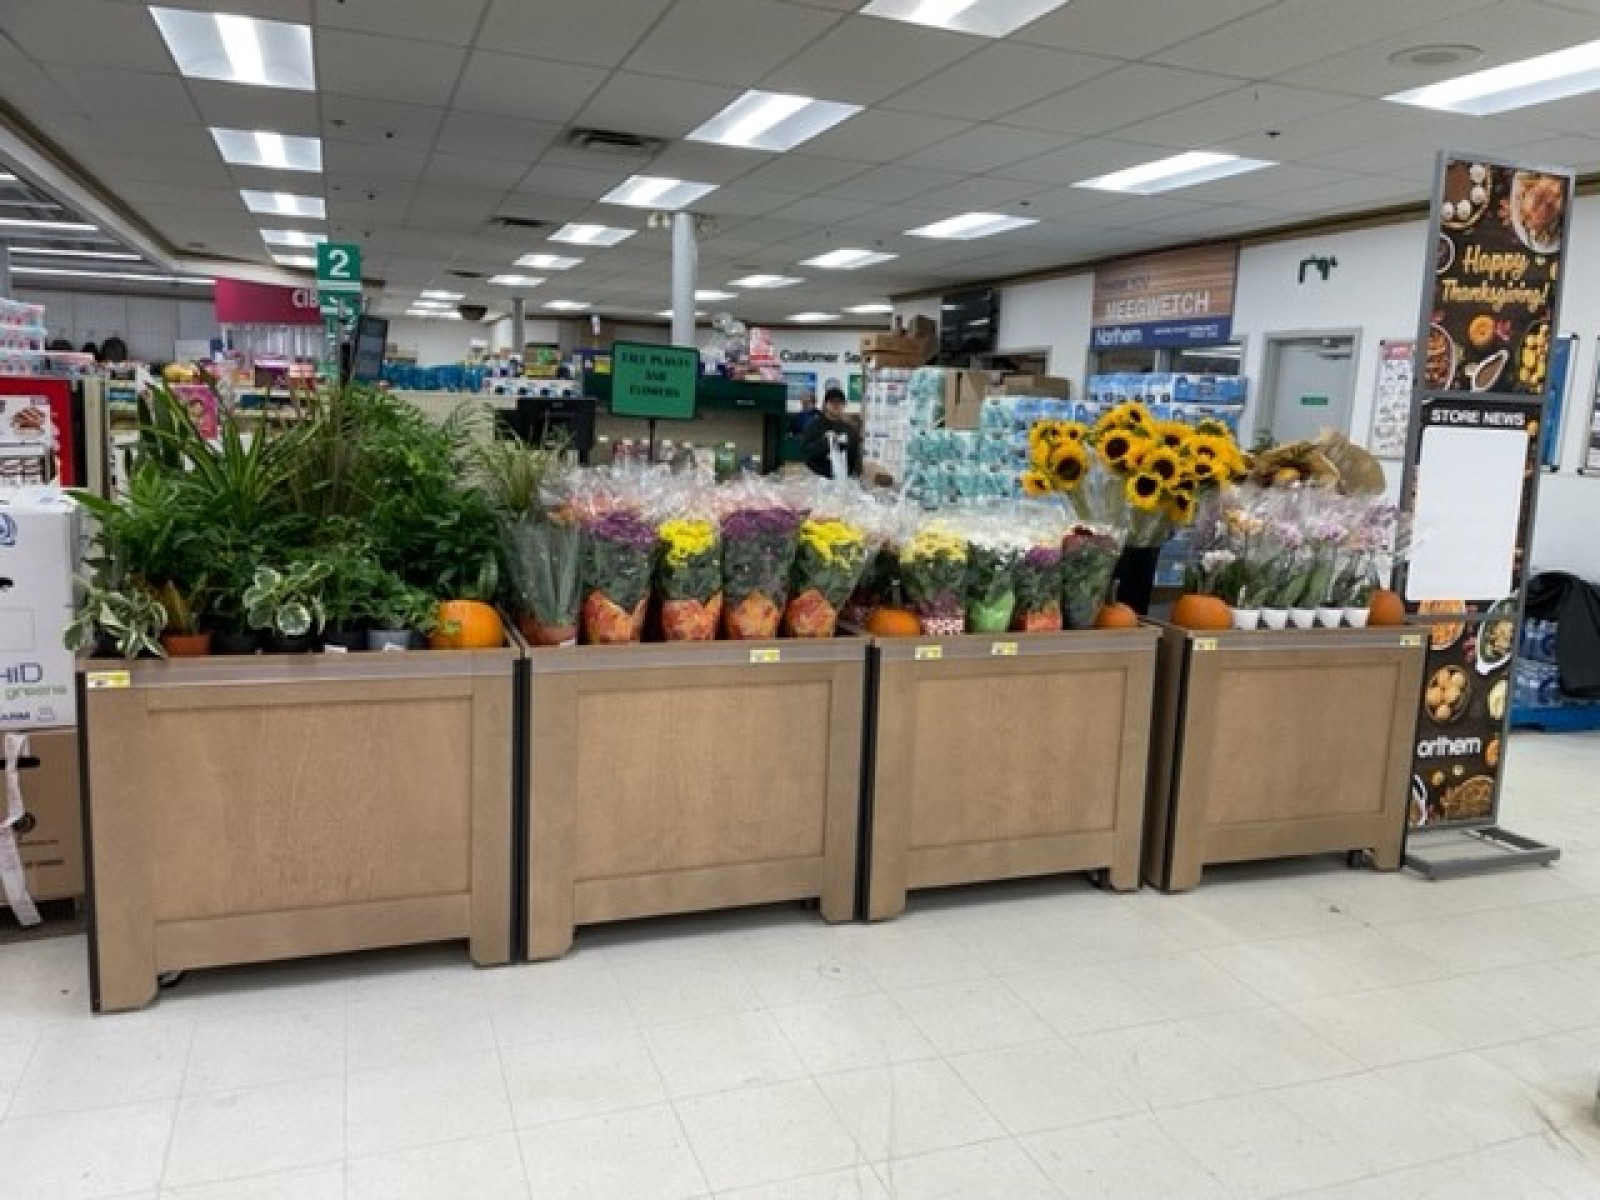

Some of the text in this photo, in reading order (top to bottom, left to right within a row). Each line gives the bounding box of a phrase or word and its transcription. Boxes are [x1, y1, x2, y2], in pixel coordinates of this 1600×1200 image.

[327, 248, 351, 278] 2
[1462, 245, 1530, 281] Happy
[1441, 279, 1550, 312] Thanksgiving!
[780, 350, 861, 364] Customer Se
[1431, 409, 1526, 426] STORE NEWS
[1417, 735, 1481, 758] orthern
